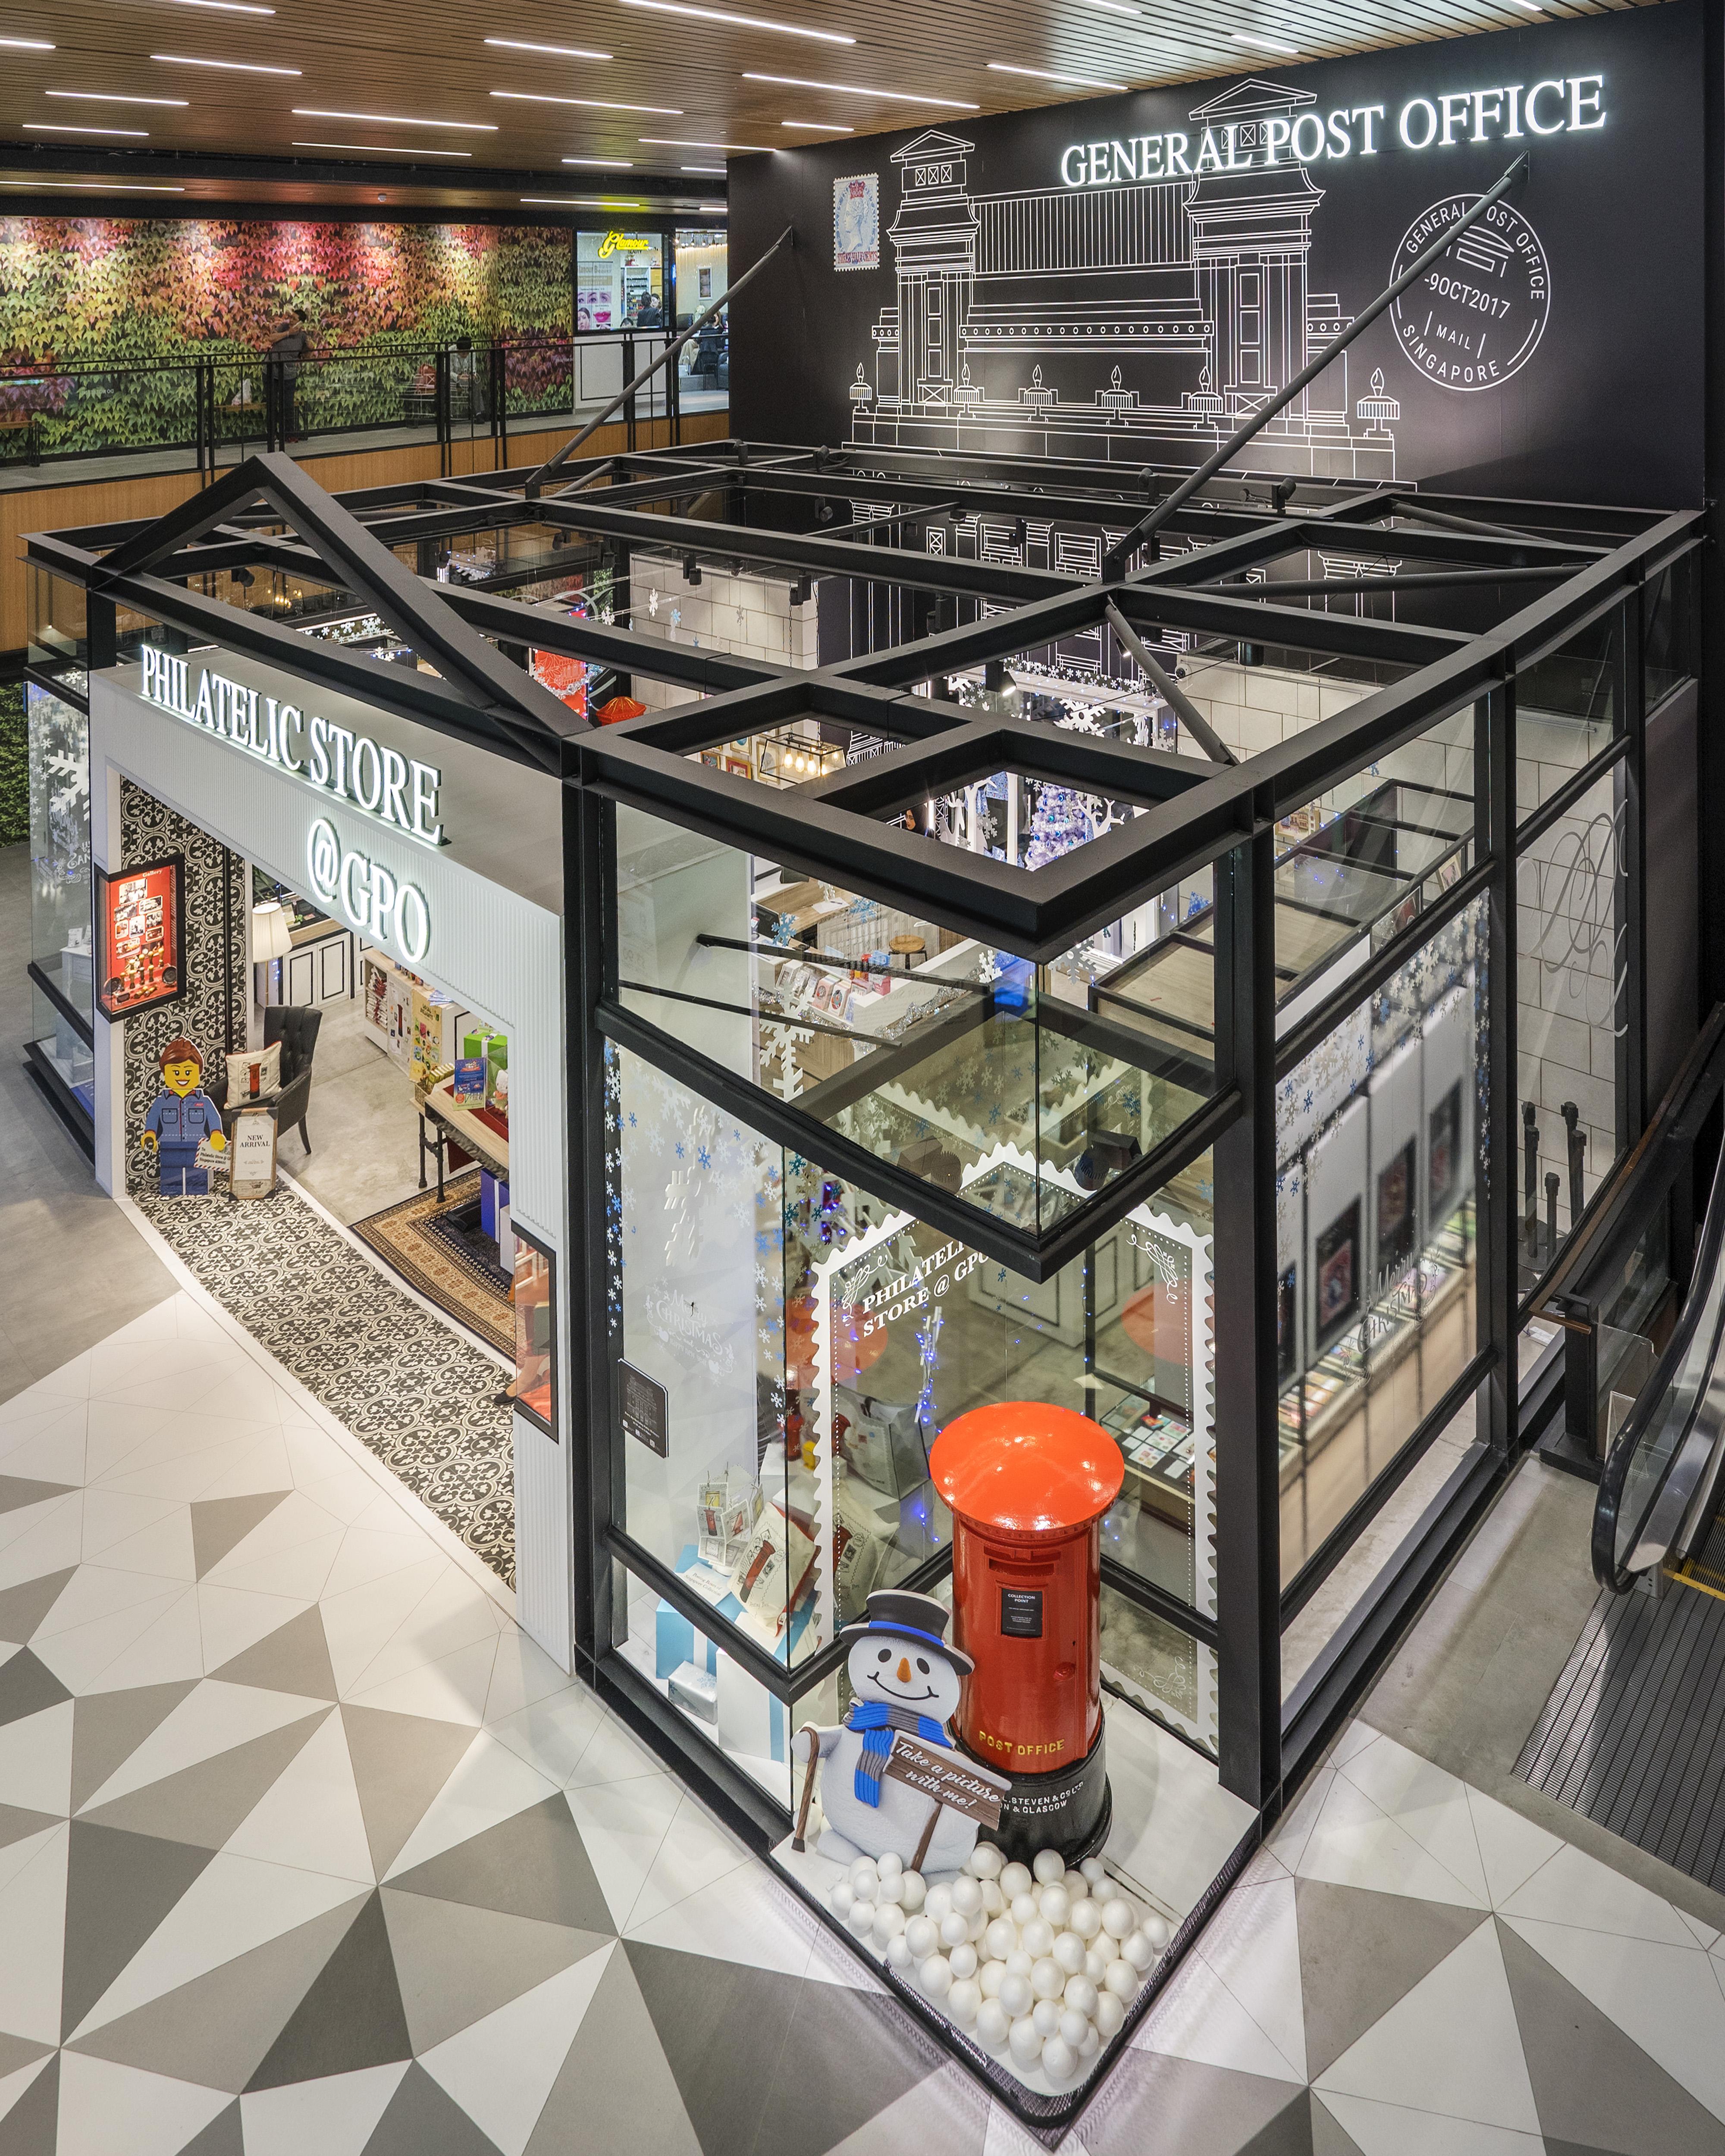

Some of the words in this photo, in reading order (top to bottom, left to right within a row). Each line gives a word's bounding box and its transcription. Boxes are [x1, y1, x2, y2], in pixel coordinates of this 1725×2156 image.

[1061, 124, 1252, 187] GENERAL
[1264, 105, 1384, 166] POST
[1399, 74, 1607, 151] OFFICE
[598, 230, 649, 258] Glamour
[1406, 202, 1467, 254] GENERAL
[1486, 205, 1518, 232] OST
[1516, 232, 1544, 300] OFFICE
[1403, 324, 1500, 383] SINGAPORE
[1436, 324, 1471, 350] MAIL
[141, 644, 304, 771] PHILATELIC
[310, 717, 444, 845] STORE
[142, 868, 163, 878] Gallery
[307, 818, 430, 963] @GPO
[862, 1241, 965, 1314] PHILATELI
[863, 1287, 929, 1338] STORE
[934, 1274, 950, 1297] @
[656, 1300, 722, 1355] CHRISTMAS
[671, 1289, 707, 1328] Mey
[692, 1573, 706, 1583] Posting
[979, 1730, 1013, 1753] POST
[1017, 1738, 1065, 1755] OFFICE
[896, 1741, 931, 1766] Take
[931, 1764, 945, 1774] a
[941, 1771, 1000, 1802] picture
[906, 1771, 944, 1793] with
[942, 1790, 978, 1809] me!
